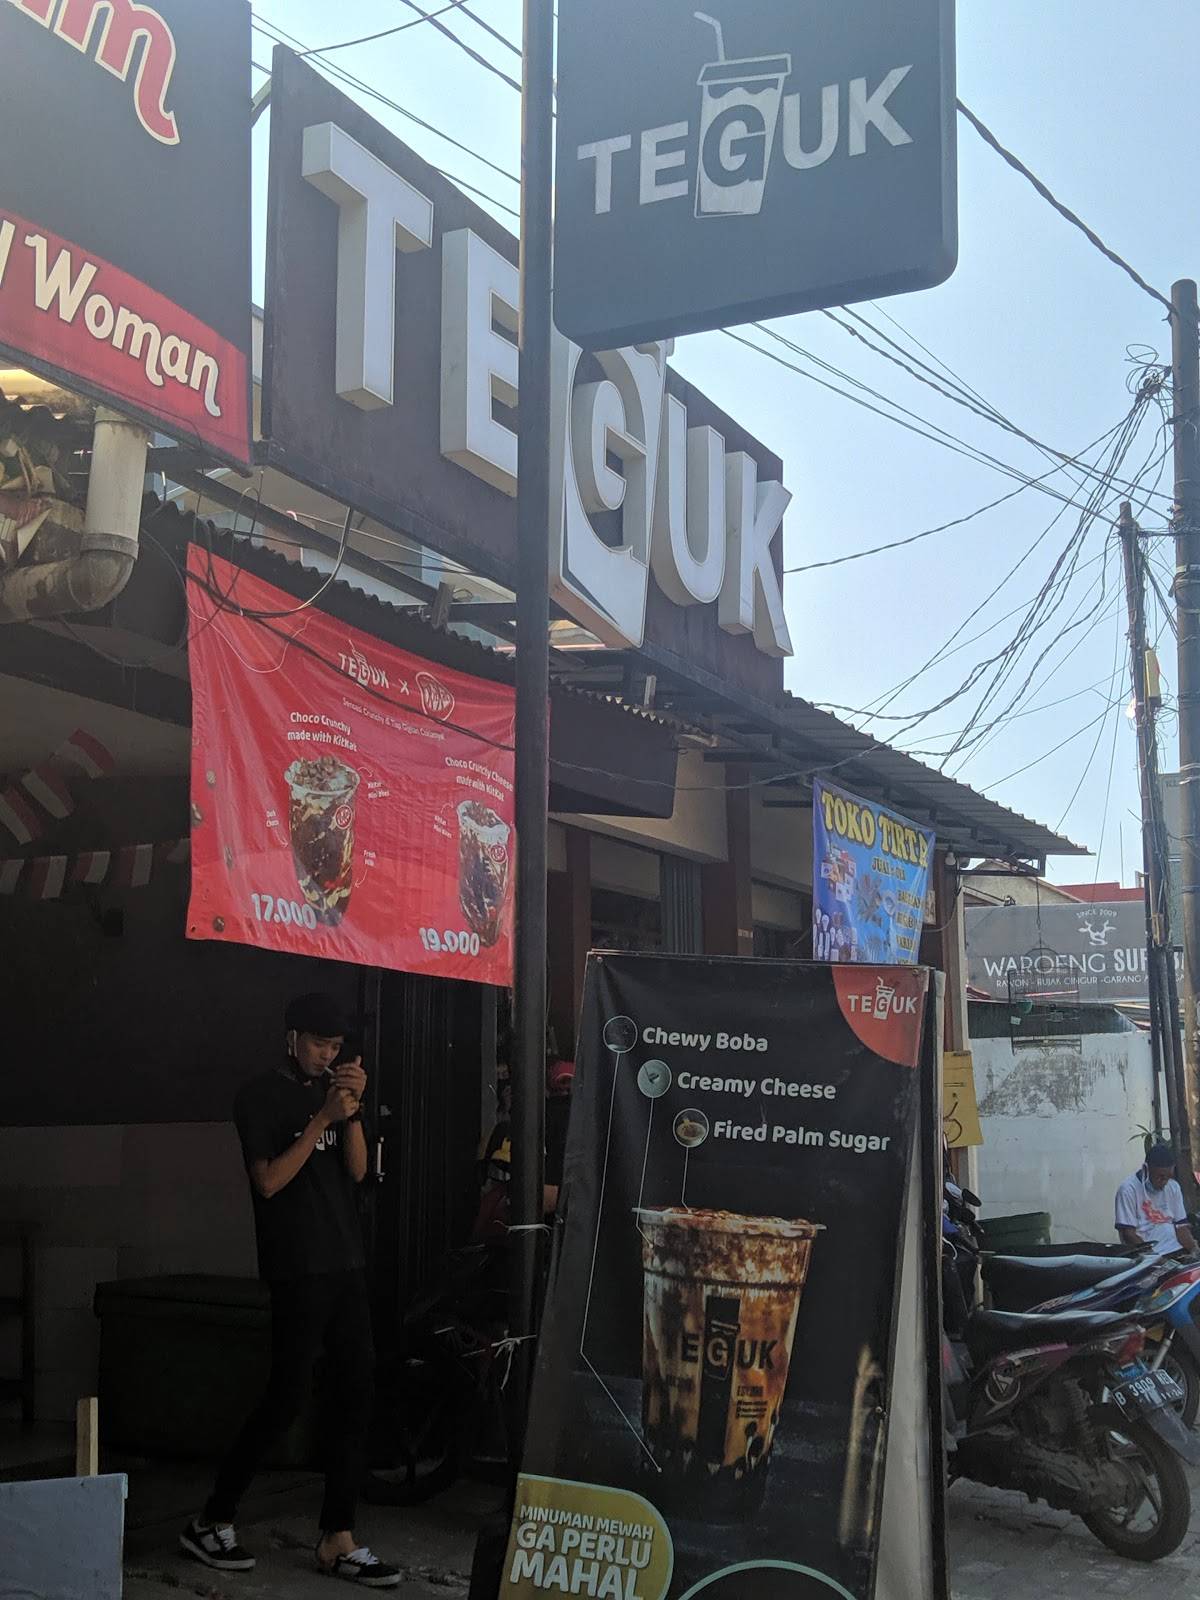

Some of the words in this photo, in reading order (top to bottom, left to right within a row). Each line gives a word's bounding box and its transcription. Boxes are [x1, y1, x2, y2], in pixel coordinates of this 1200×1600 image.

[577, 65, 913, 214] TEGUK
[24, 234, 220, 416] Woman
[287, 730, 310, 741] made
[312, 731, 331, 743] with
[290, 711, 320, 723] Choco
[321, 716, 351, 735] Crunchy
[445, 756, 467, 769] Choco
[468, 760, 491, 779] Crunchy
[491, 771, 514, 791] Cheese
[456, 775, 472, 787] made
[472, 779, 485, 791] with
[822, 790, 875, 847] TOKO
[251, 893, 317, 929] 17.000
[419, 927, 480, 956] 19.000
[983, 953, 1106, 977] WAROENG
[847, 992, 918, 1019] TEGUK
[643, 1027, 711, 1051] Chewy
[716, 1032, 768, 1051] Boba
[678, 1072, 756, 1097] Creamy
[760, 1078, 836, 1099] Cheese
[713, 1120, 767, 1141] Fired
[772, 1126, 823, 1146] Palm
[828, 1130, 890, 1153] Sugar
[1115, 1391, 1126, 1405] B
[1129, 1377, 1155, 1397] 3909
[520, 1504, 593, 1531] MINUMAN
[596, 1517, 654, 1540] MEWAH
[516, 1522, 556, 1552] GA
[562, 1529, 652, 1568] PERLU
[510, 1549, 644, 1600] MAHAL
